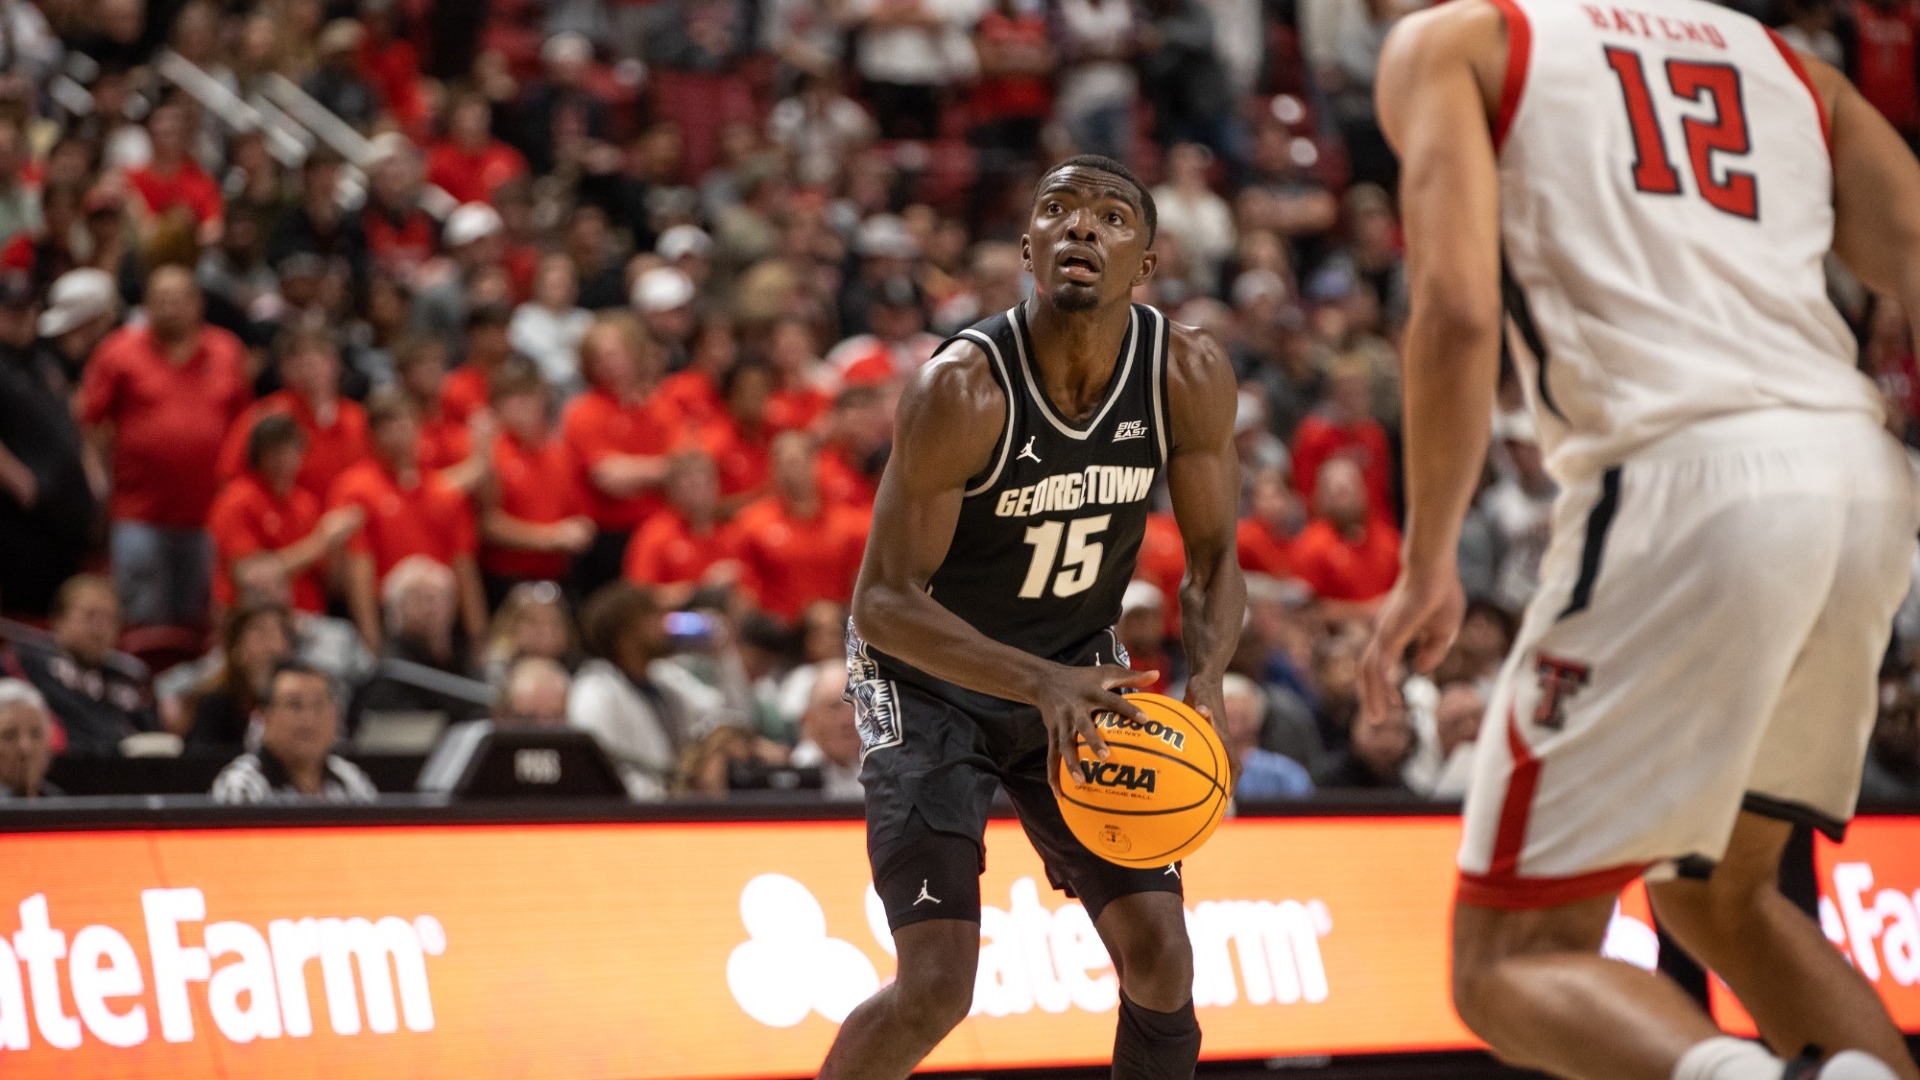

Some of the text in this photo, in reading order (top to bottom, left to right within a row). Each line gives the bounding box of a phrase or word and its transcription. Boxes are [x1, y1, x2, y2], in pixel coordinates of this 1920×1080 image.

[1603, 43, 1759, 221] 12
[1114, 427, 1148, 438] EAST
[1117, 420, 1142, 430] BIG
[995, 465, 1155, 517] GEORGTOWN
[1017, 513, 1112, 598] 15
[1095, 712, 1184, 752] ilson
[1080, 758, 1157, 793] NCAA
